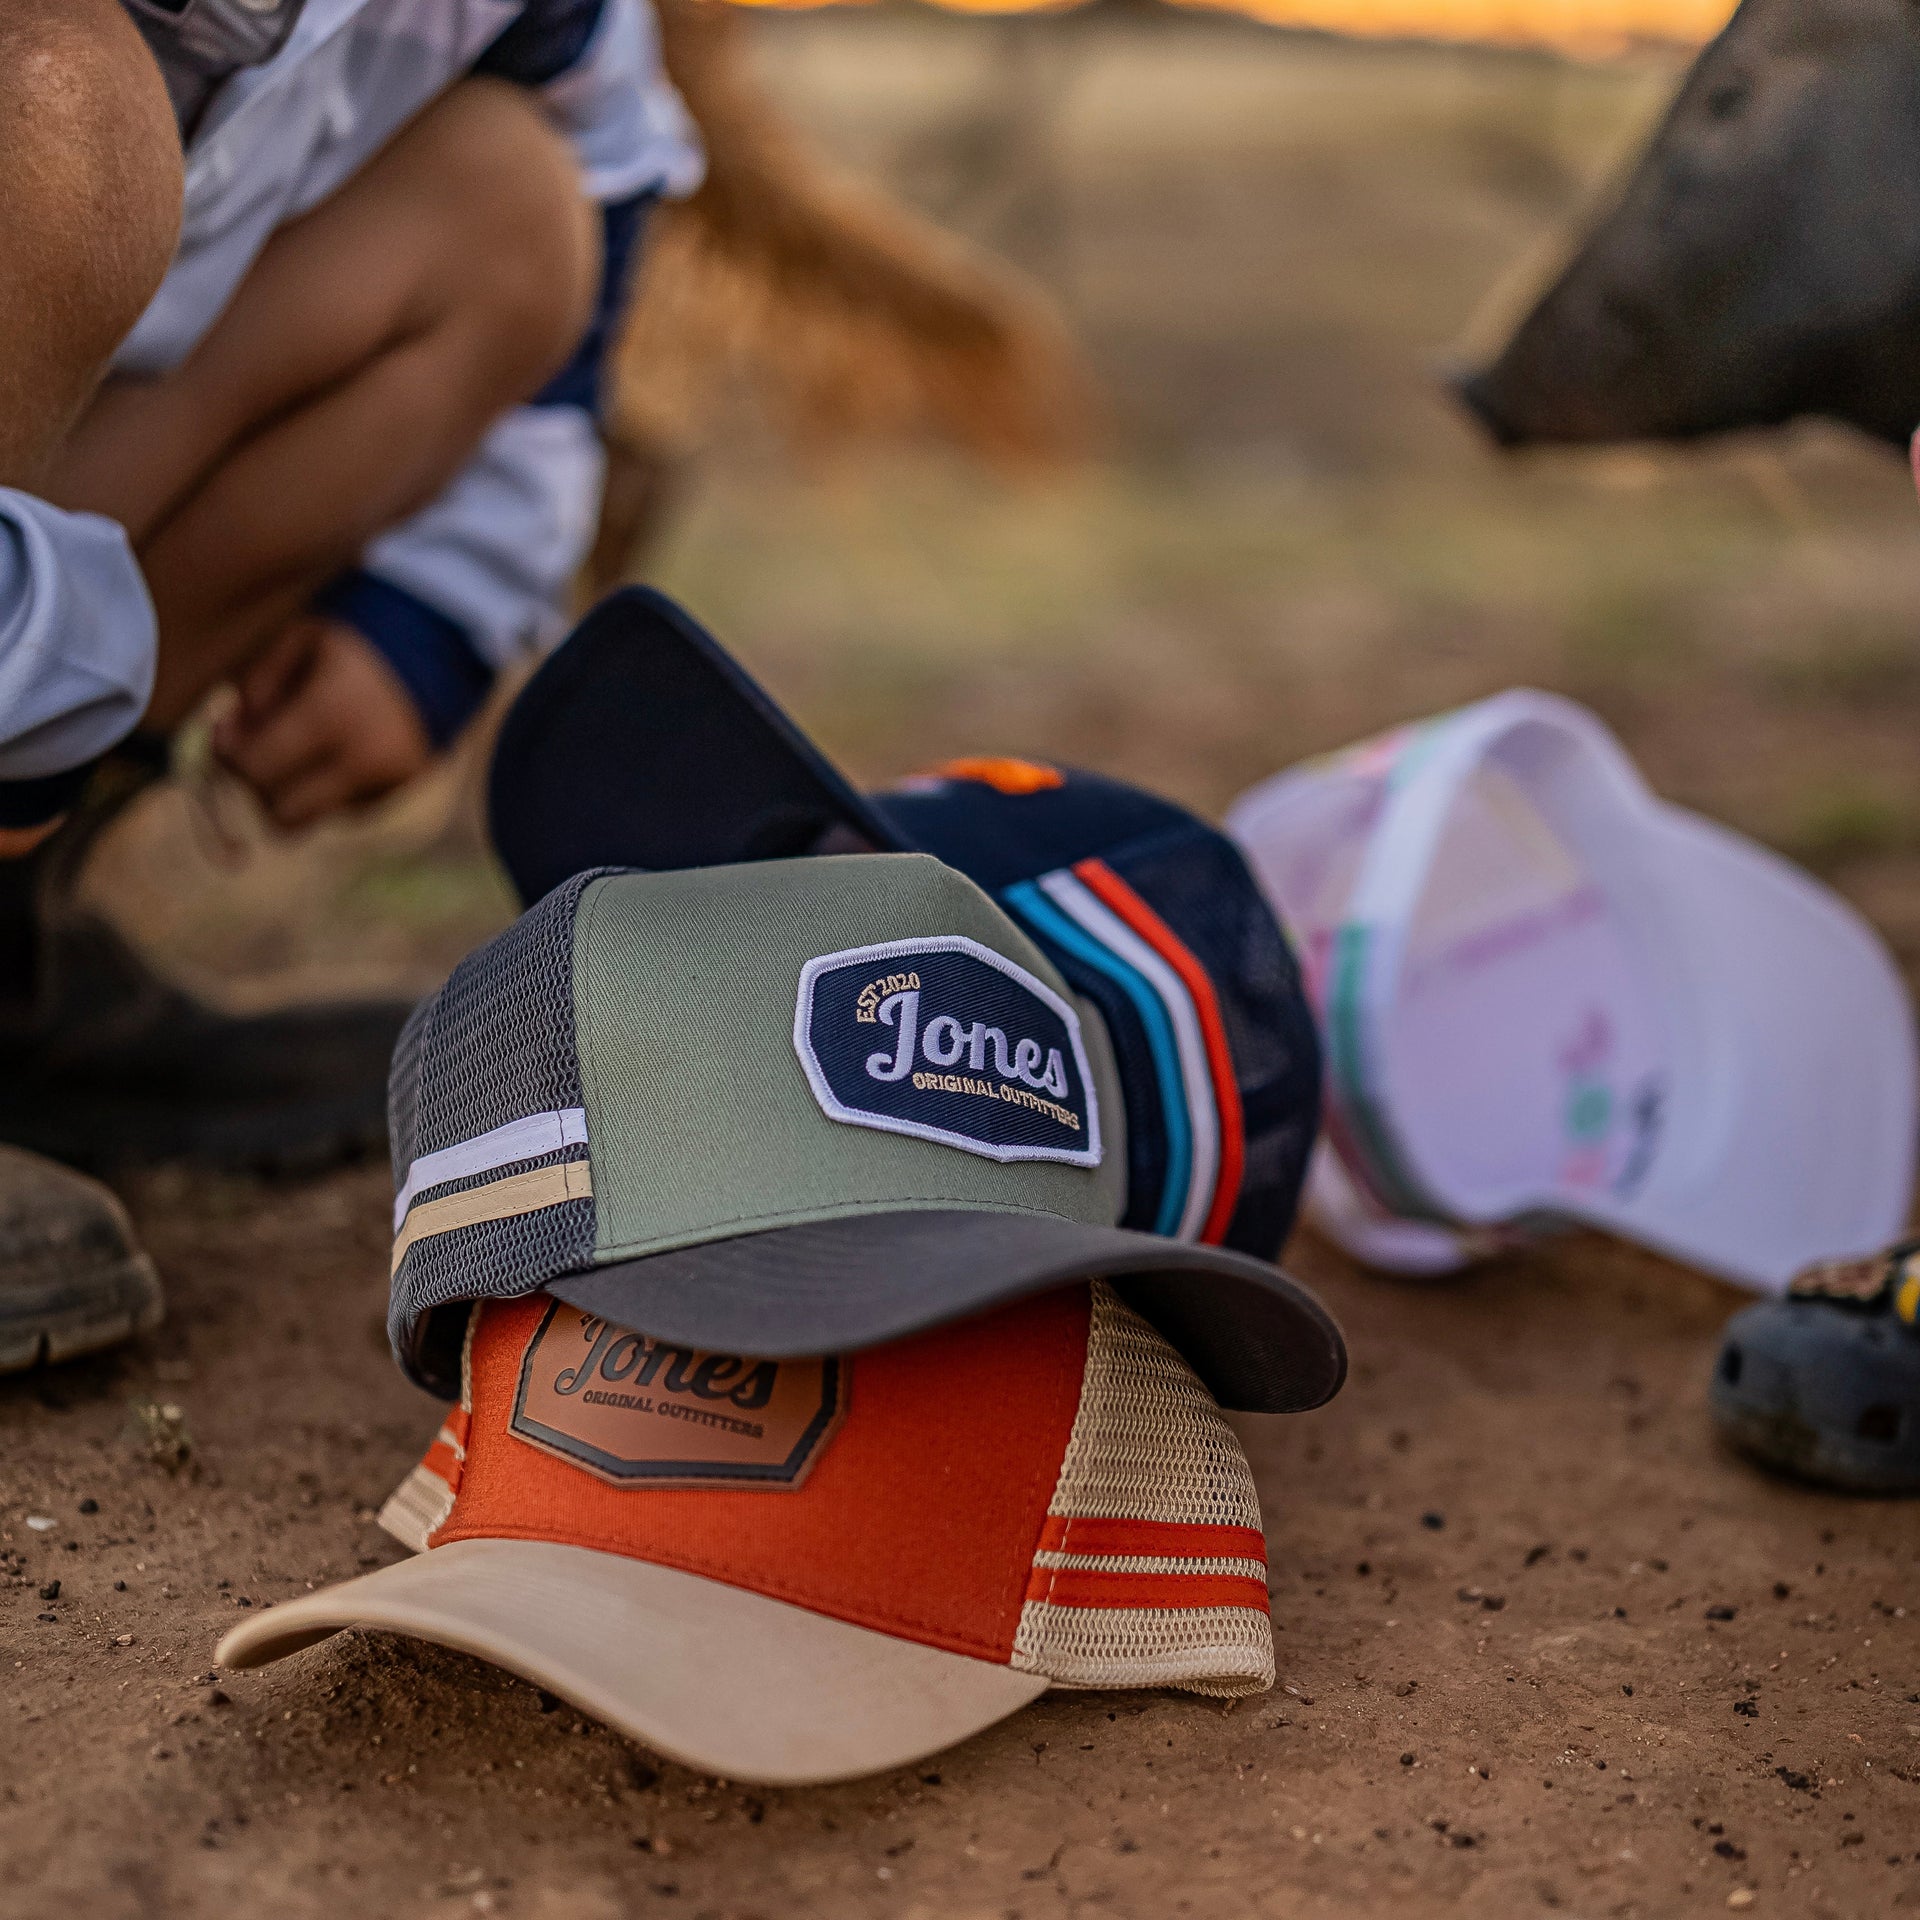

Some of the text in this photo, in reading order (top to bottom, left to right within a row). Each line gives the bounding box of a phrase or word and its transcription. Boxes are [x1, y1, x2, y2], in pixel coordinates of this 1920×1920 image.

[857, 972, 921, 1023] EST 2020
[865, 991, 1069, 1099] Jones
[912, 1072, 1081, 1131] ORIGINAL OUTFITTERS
[554, 1316, 779, 1410] Jones
[583, 1389, 765, 1439] ORIGINAL OUTFITTERS
